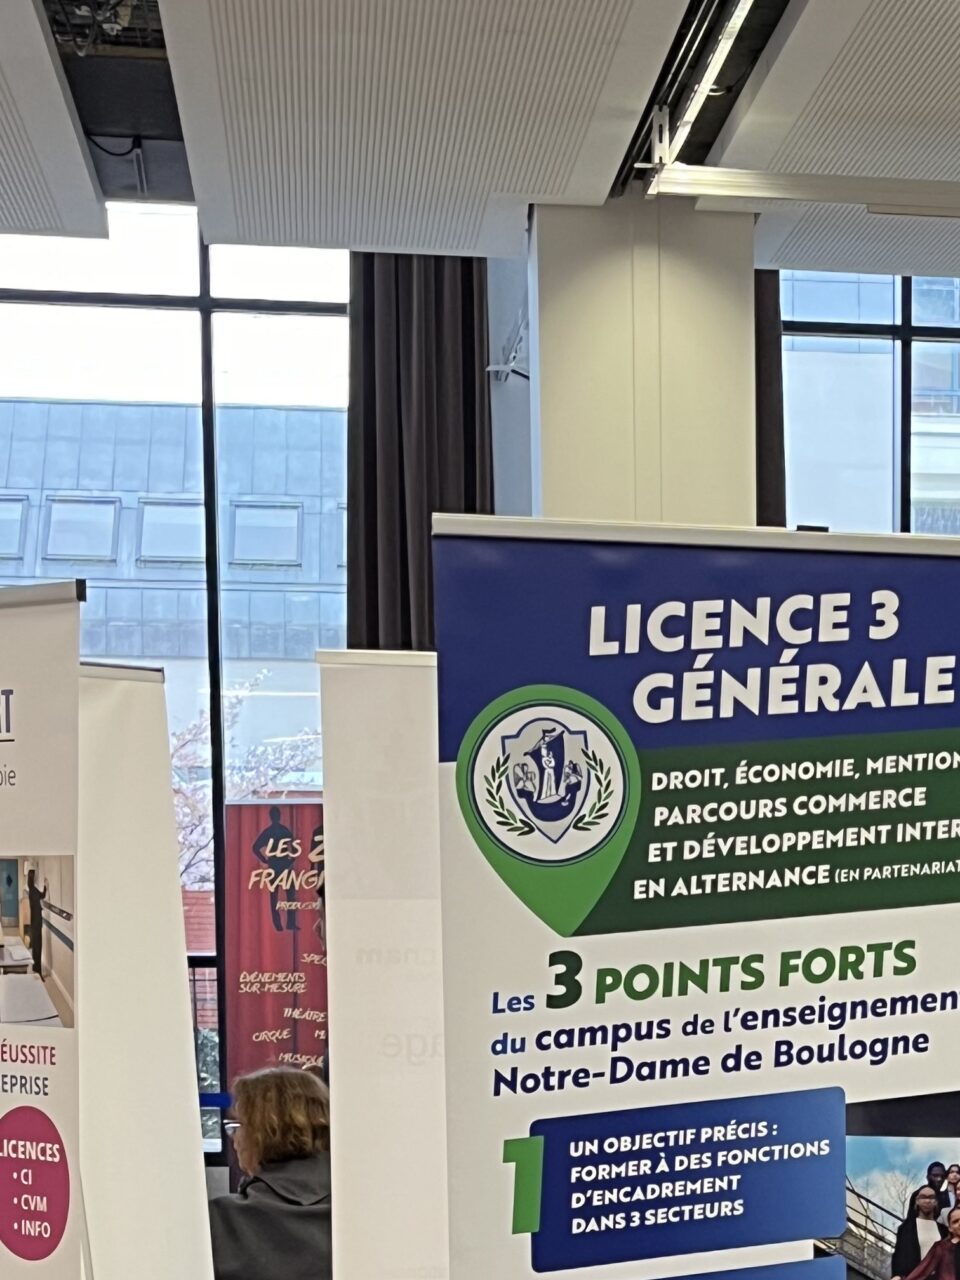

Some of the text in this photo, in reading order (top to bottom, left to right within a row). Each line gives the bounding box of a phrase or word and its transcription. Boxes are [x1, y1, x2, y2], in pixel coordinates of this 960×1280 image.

[589, 590, 900, 656] LICENCE 3
[633, 649, 957, 724] GÉNÉRALE
[652, 768, 729, 791] DROIT,
[735, 758, 861, 784] ÉCONOMIE,
[654, 788, 927, 827] PARCOURS COMMERCE
[266, 838, 300, 857] LES
[649, 840, 679, 863] ET
[685, 822, 890, 860] DÉVELOPPEMENT
[634, 878, 665, 898] EN
[671, 865, 831, 897] ALTERNANCE
[834, 869, 858, 883] (EN
[491, 940, 916, 1014] Les 3 POINTS FORTS
[1, 1039, 56, 1065] ÉUSSITE
[253, 1029, 291, 1042] CIRQUE
[491, 1033, 526, 1056] du
[535, 1017, 671, 1057] campus
[682, 1014, 715, 1037] de
[492, 1029, 930, 1096] Notre-Dame de Boulogne
[2, 1074, 49, 1096] EPRISE
[570, 1121, 768, 1158] UN OBJECTIF PRÉCIS
[571, 1140, 830, 1183] FORMER À DES FONCTIONS
[21, 1195, 47, 1212] CVM
[503, 1135, 545, 1235] 1
[22, 1219, 50, 1238] INFO
[571, 1199, 744, 1235] DANS 3 SECTEURS
